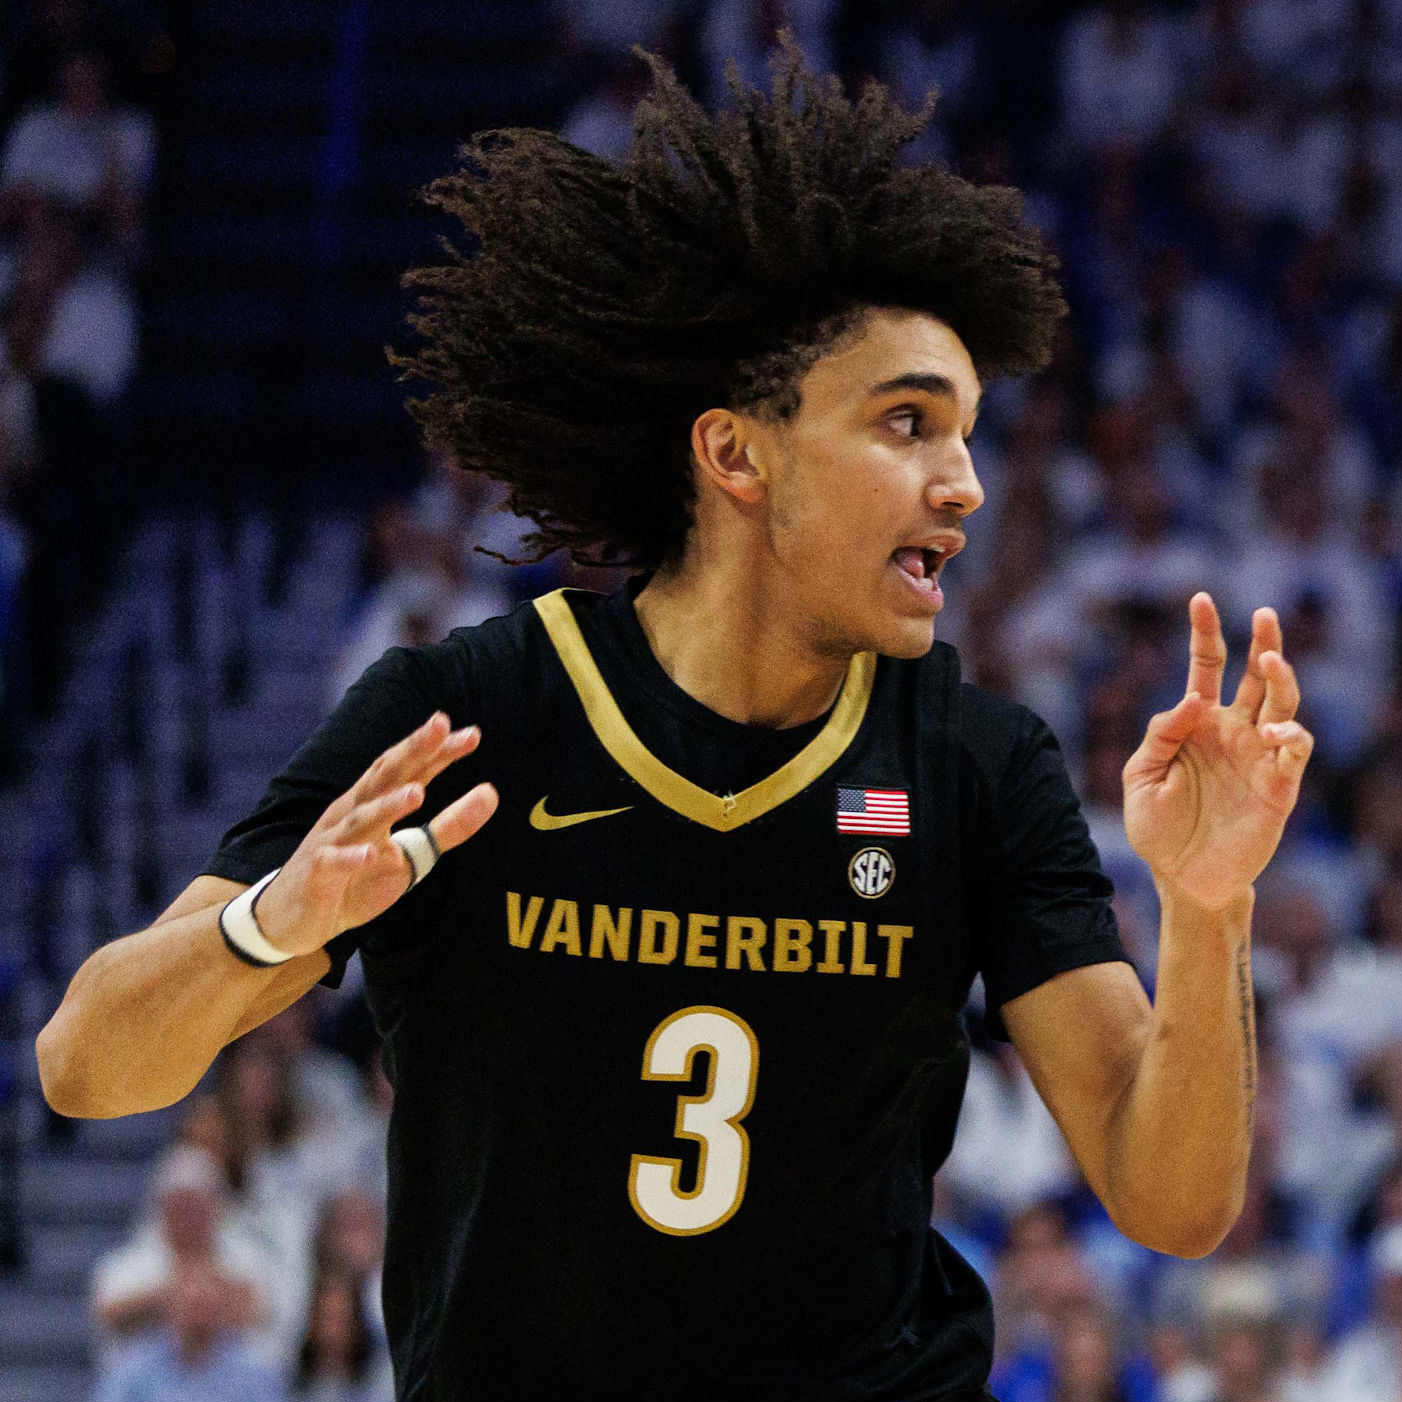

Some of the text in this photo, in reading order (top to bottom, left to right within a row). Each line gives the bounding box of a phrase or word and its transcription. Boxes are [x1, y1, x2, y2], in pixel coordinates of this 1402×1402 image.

[852, 851, 892, 895] SEC
[505, 891, 914, 978] VANDERBILT
[628, 1005, 760, 1237] 3
